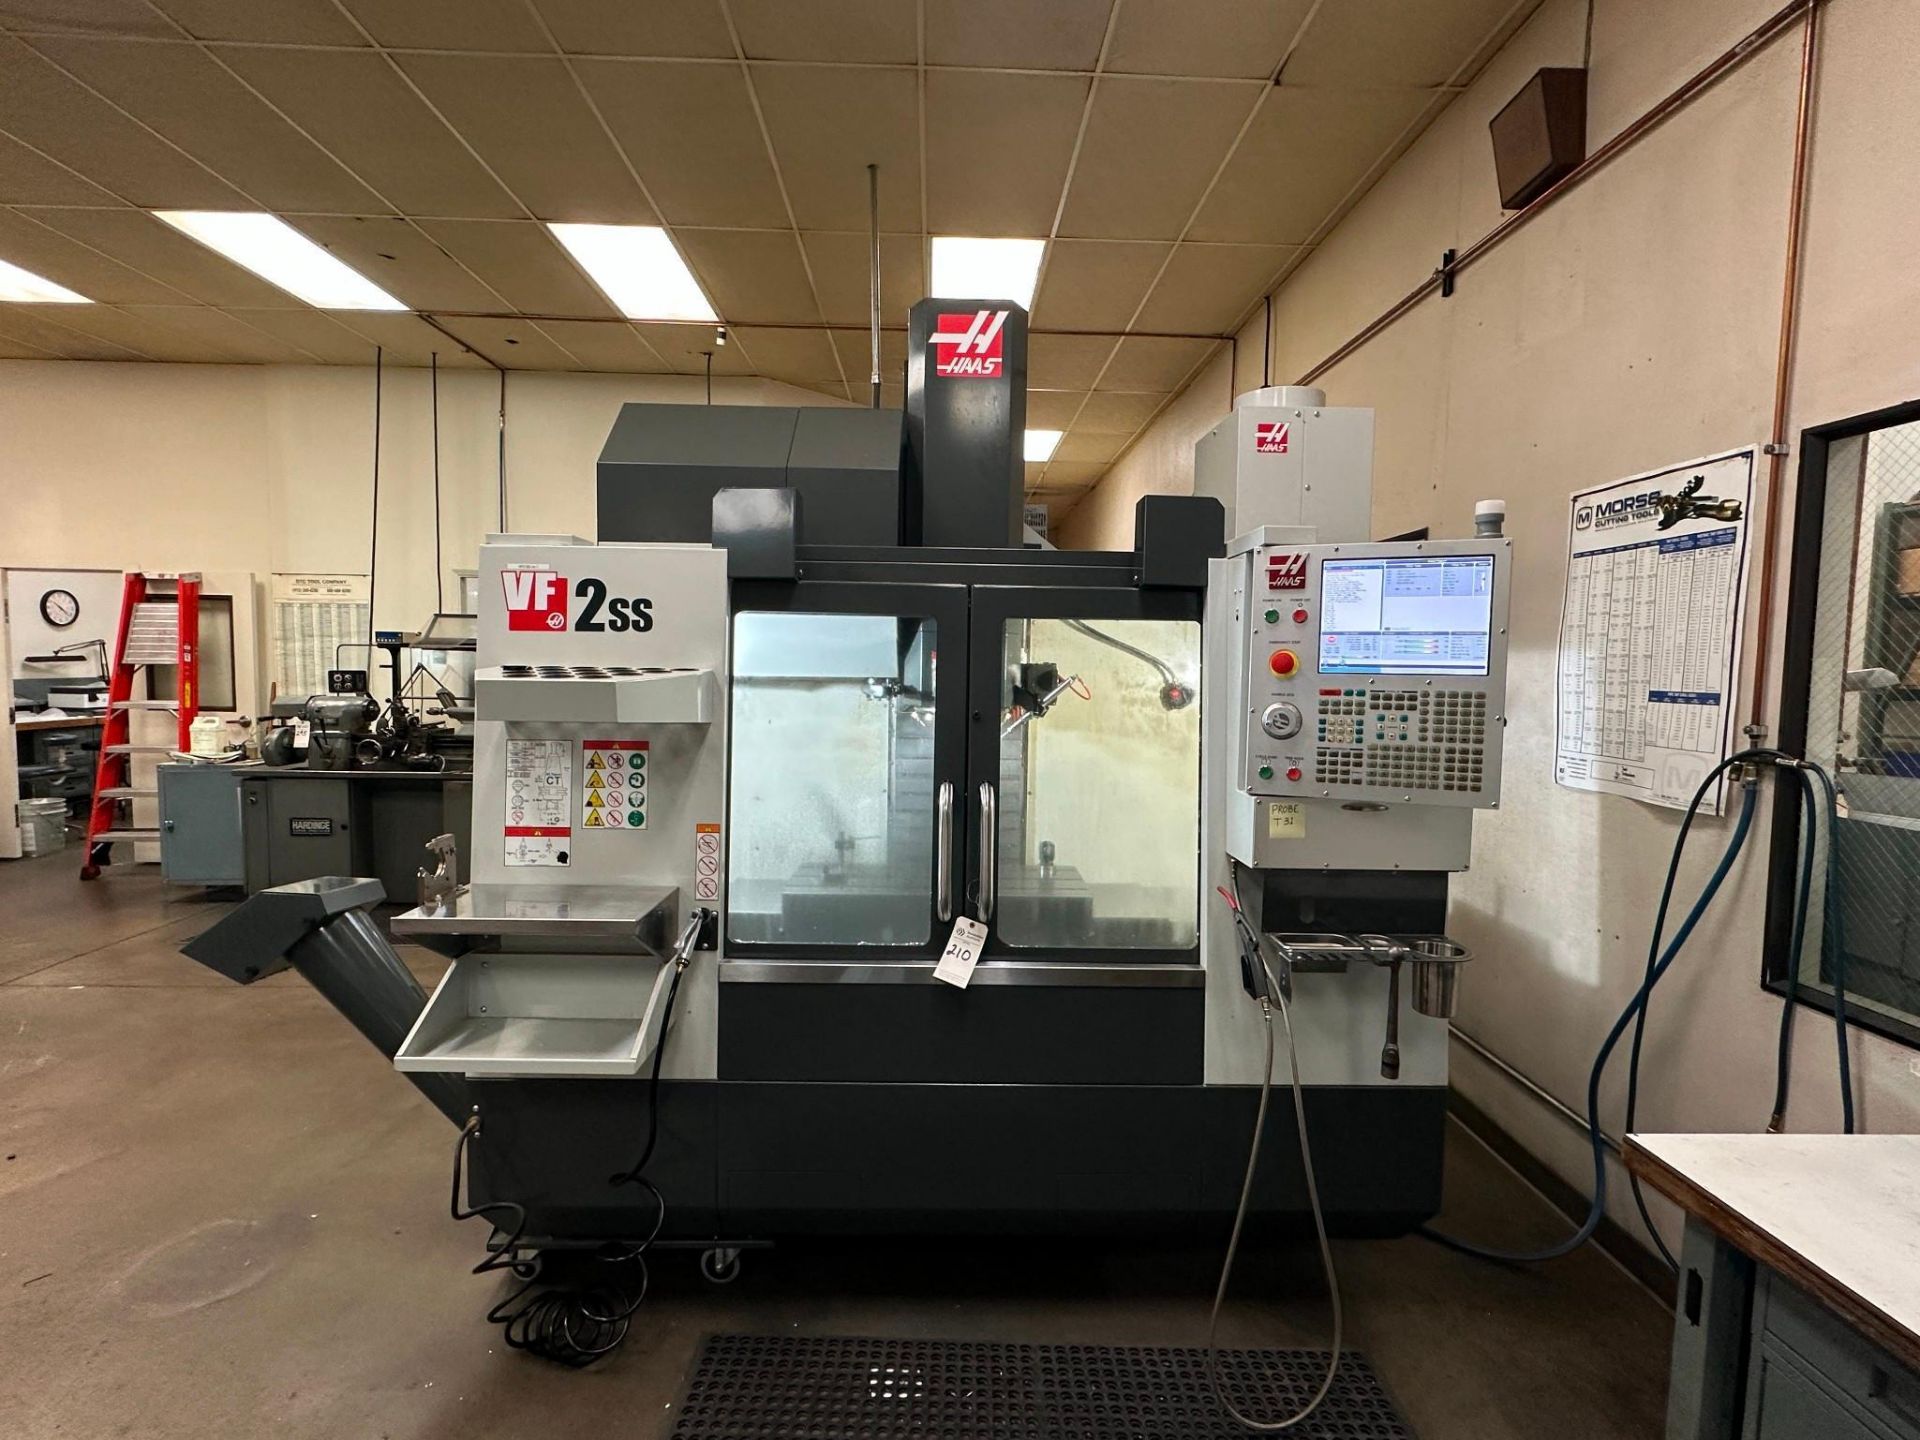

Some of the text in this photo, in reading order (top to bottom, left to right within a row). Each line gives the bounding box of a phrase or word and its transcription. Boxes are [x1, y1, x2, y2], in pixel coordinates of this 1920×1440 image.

[937, 357, 1002, 374] HAAS
[1256, 443, 1287, 452] HAAS
[1595, 514, 1629, 528] CUTTING
[1631, 508, 1660, 521] TOOLS
[1269, 576, 1304, 586] HAAS
[501, 571, 558, 611] VF
[546, 776, 561, 785] CT
[1271, 804, 1299, 815] PROBE
[292, 821, 330, 830] HARDINGE
[1274, 817, 1281, 827] T
[946, 944, 971, 961] 210
